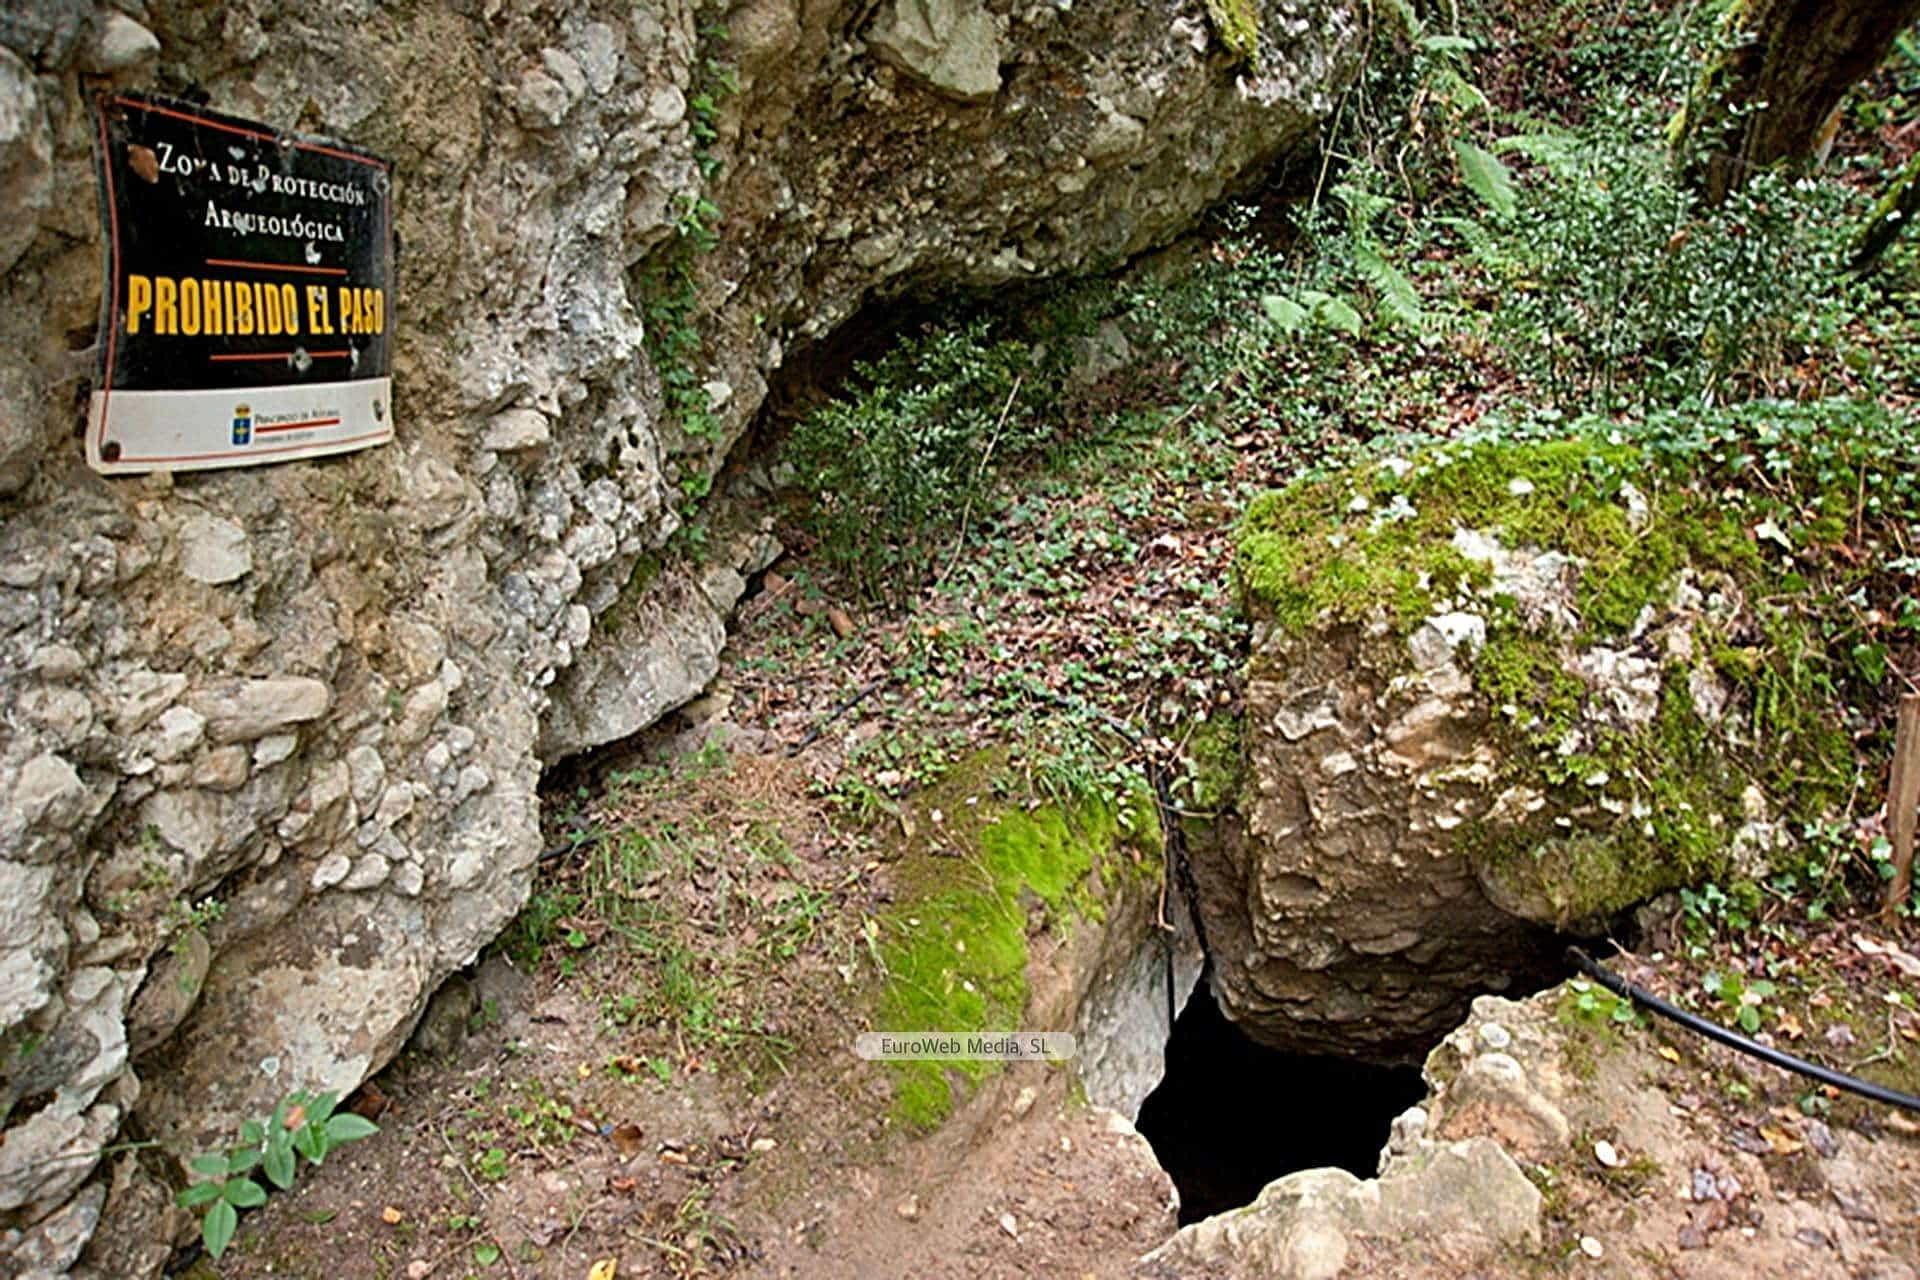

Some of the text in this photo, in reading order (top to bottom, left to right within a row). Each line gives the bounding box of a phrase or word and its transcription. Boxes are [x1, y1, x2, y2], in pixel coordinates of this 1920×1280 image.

[227, 165, 251, 187] DE
[257, 164, 364, 206] PROTECCIÓN
[204, 200, 344, 242] ARQUEOLÓGICA
[126, 274, 384, 336] PROHIBIDO EL PASO
